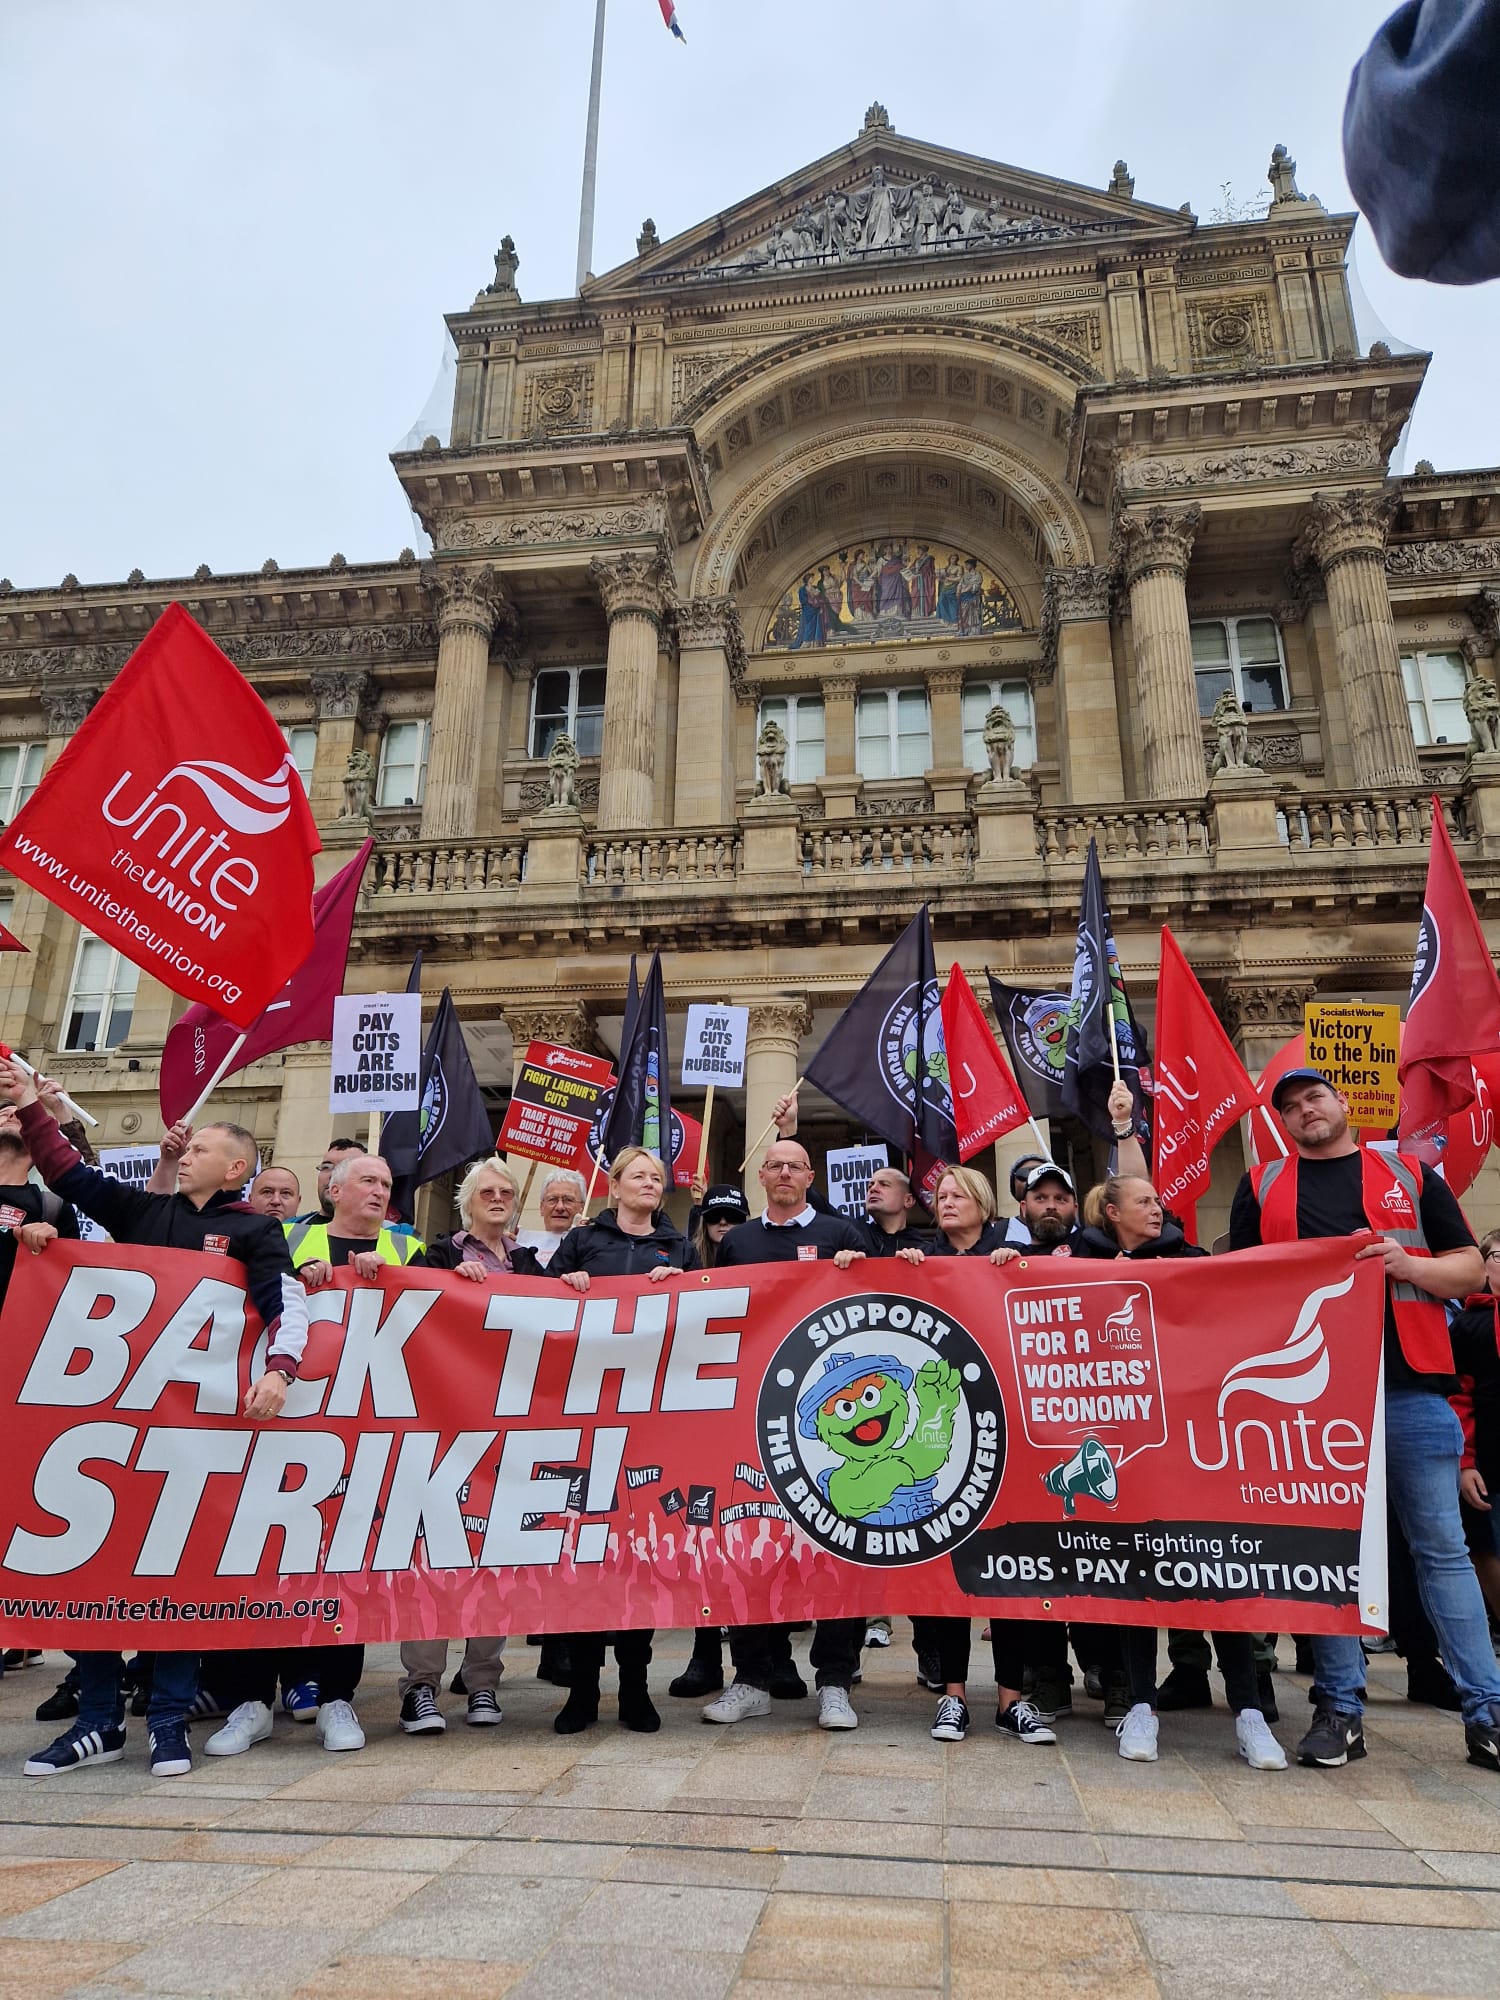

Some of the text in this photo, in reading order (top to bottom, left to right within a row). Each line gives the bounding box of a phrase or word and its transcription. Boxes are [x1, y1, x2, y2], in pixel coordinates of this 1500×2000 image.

[13, 834, 243, 1004] www.unitetheunion.org
[358, 1012, 394, 1031] PAY
[704, 1017, 730, 1031] PAY
[1320, 1007, 1385, 1017] Socialist Worker
[352, 1032, 400, 1052] CUTS
[699, 1030, 733, 1046] CUTS
[1309, 1018, 1373, 1044] Victory
[194, 1026, 206, 1076] EGION
[701, 1044, 728, 1059] ARE
[886, 1005, 913, 1090] THE BRUM
[1019, 1031, 1032, 1056] THE
[1031, 1054, 1065, 1080] BRUM
[1309, 1041, 1396, 1064] to the bin
[357, 1052, 395, 1072] ARE
[685, 1058, 742, 1074] RUBBISH
[333, 1072, 417, 1093] RUBBISH
[523, 1068, 598, 1102] FIGHT LABOUR'S
[544, 1090, 570, 1108] CUTS
[1352, 1090, 1396, 1105] scabbing
[520, 1106, 579, 1132] TRADE UNIONS
[1357, 1106, 1375, 1116] can
[1378, 1105, 1394, 1117] win
[507, 1128, 578, 1157] WORKERS' PARTY
[519, 1119, 573, 1143] BUILD A NEW
[589, 1125, 600, 1146] THE
[505, 1142, 571, 1166] socialistparty.org.uk
[841, 1181, 868, 1203] TH
[1013, 1296, 1083, 1325] UNITE
[807, 1303, 951, 1348] SUPPORT
[485, 1287, 750, 1417] THE
[1020, 1328, 1090, 1357] FOR A
[1023, 1359, 1151, 1389] WORKERS'
[1031, 1394, 1153, 1423] ECONOMY
[627, 1468, 660, 1488] UNITE
[735, 1464, 766, 1489] UNITE
[766, 1409, 997, 1556] THE BRUM BIN WORKERS
[2, 1421, 628, 1577] STRIKE!
[721, 1503, 790, 1525] UNITE THE UNION
[1057, 1531, 1111, 1551] Unite
[1134, 1533, 1223, 1558] Fighting
[1230, 1533, 1263, 1555] for
[980, 1555, 1360, 1593] JOBS PAY CONDITIONS
[0, 1596, 340, 1622] ww.unitetheunion.org
